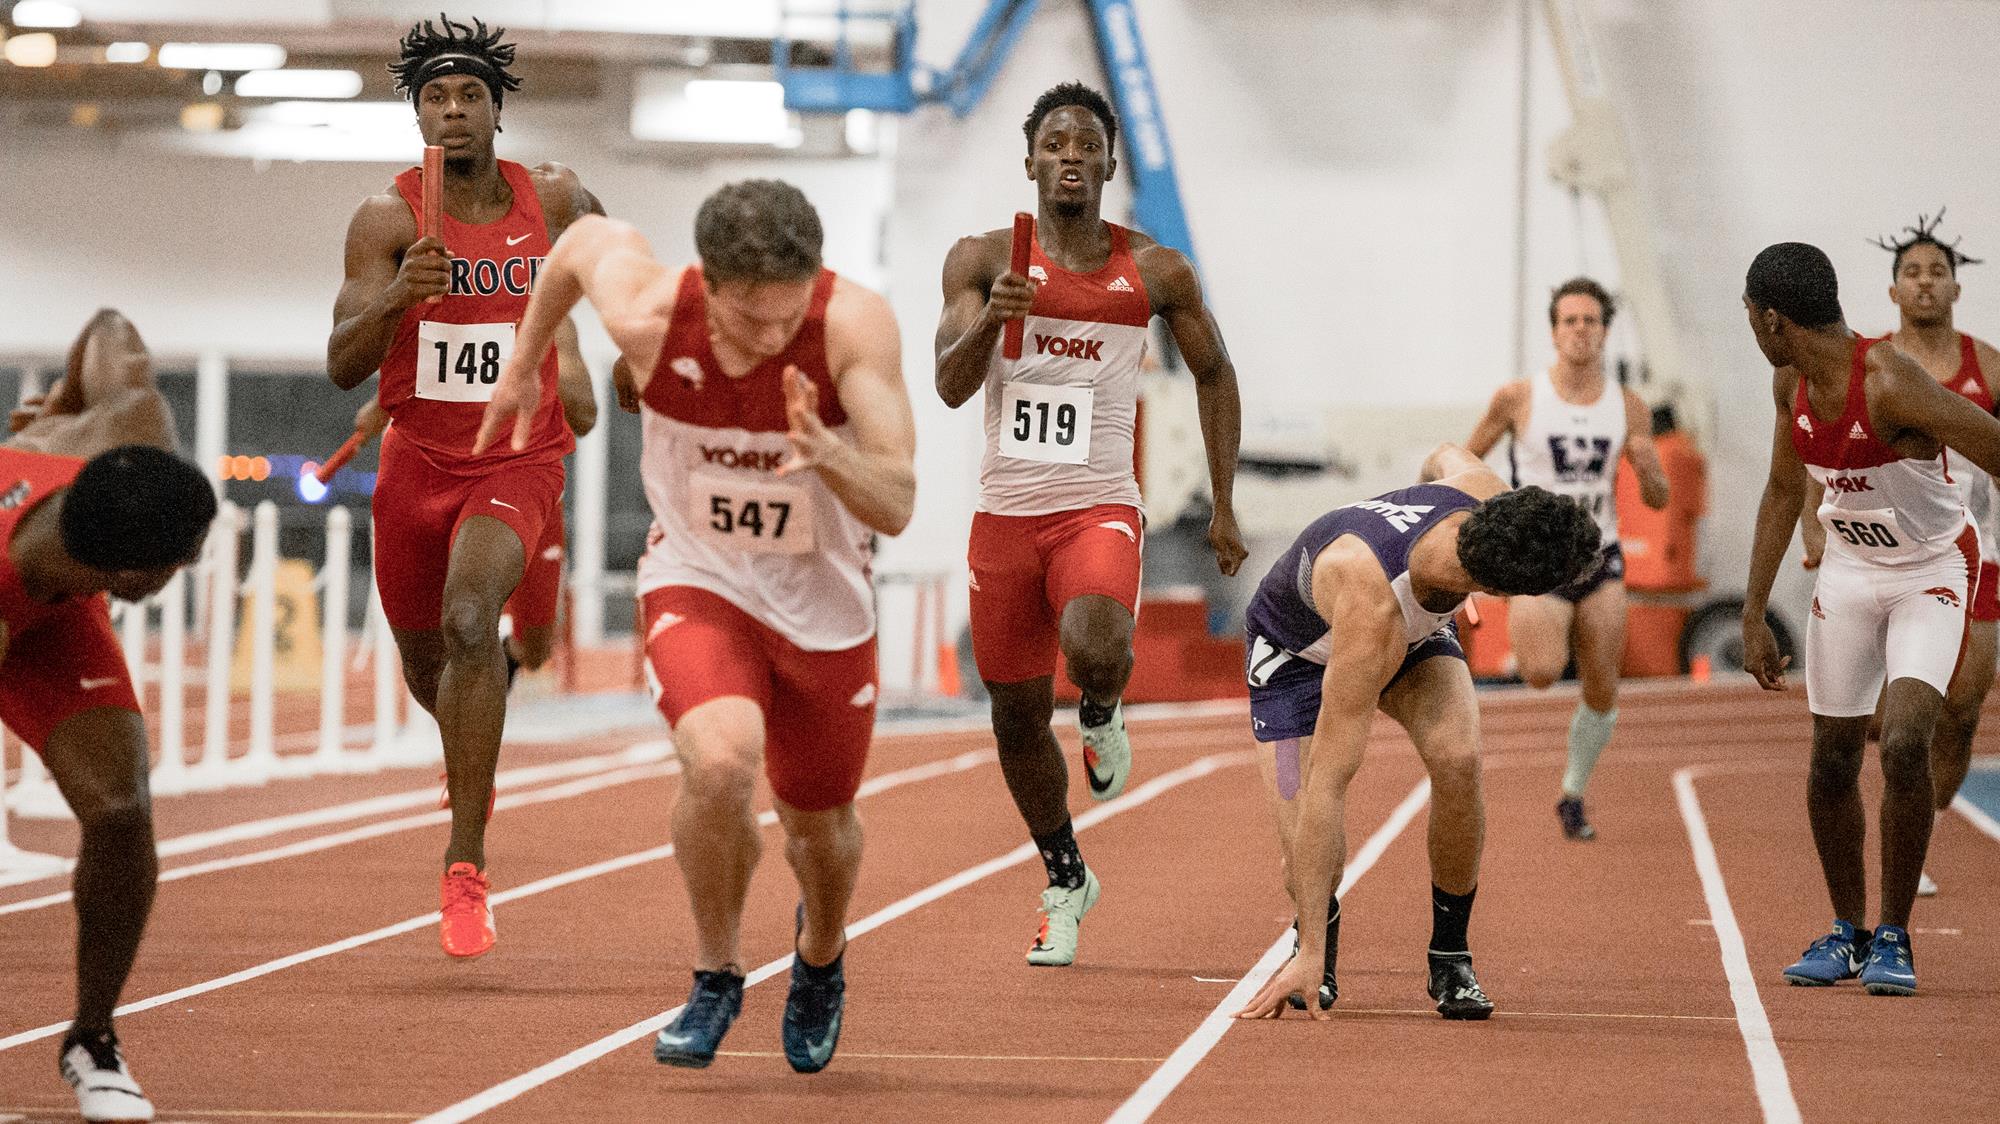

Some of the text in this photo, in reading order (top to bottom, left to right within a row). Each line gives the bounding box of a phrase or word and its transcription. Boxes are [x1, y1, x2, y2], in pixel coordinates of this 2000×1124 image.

[434, 341, 500, 385] 148
[1034, 333, 1105, 362] YORK
[1013, 399, 1077, 446] 519
[699, 443, 783, 471] YORK
[710, 495, 791, 538] 547
[1830, 518, 1900, 548] 560
